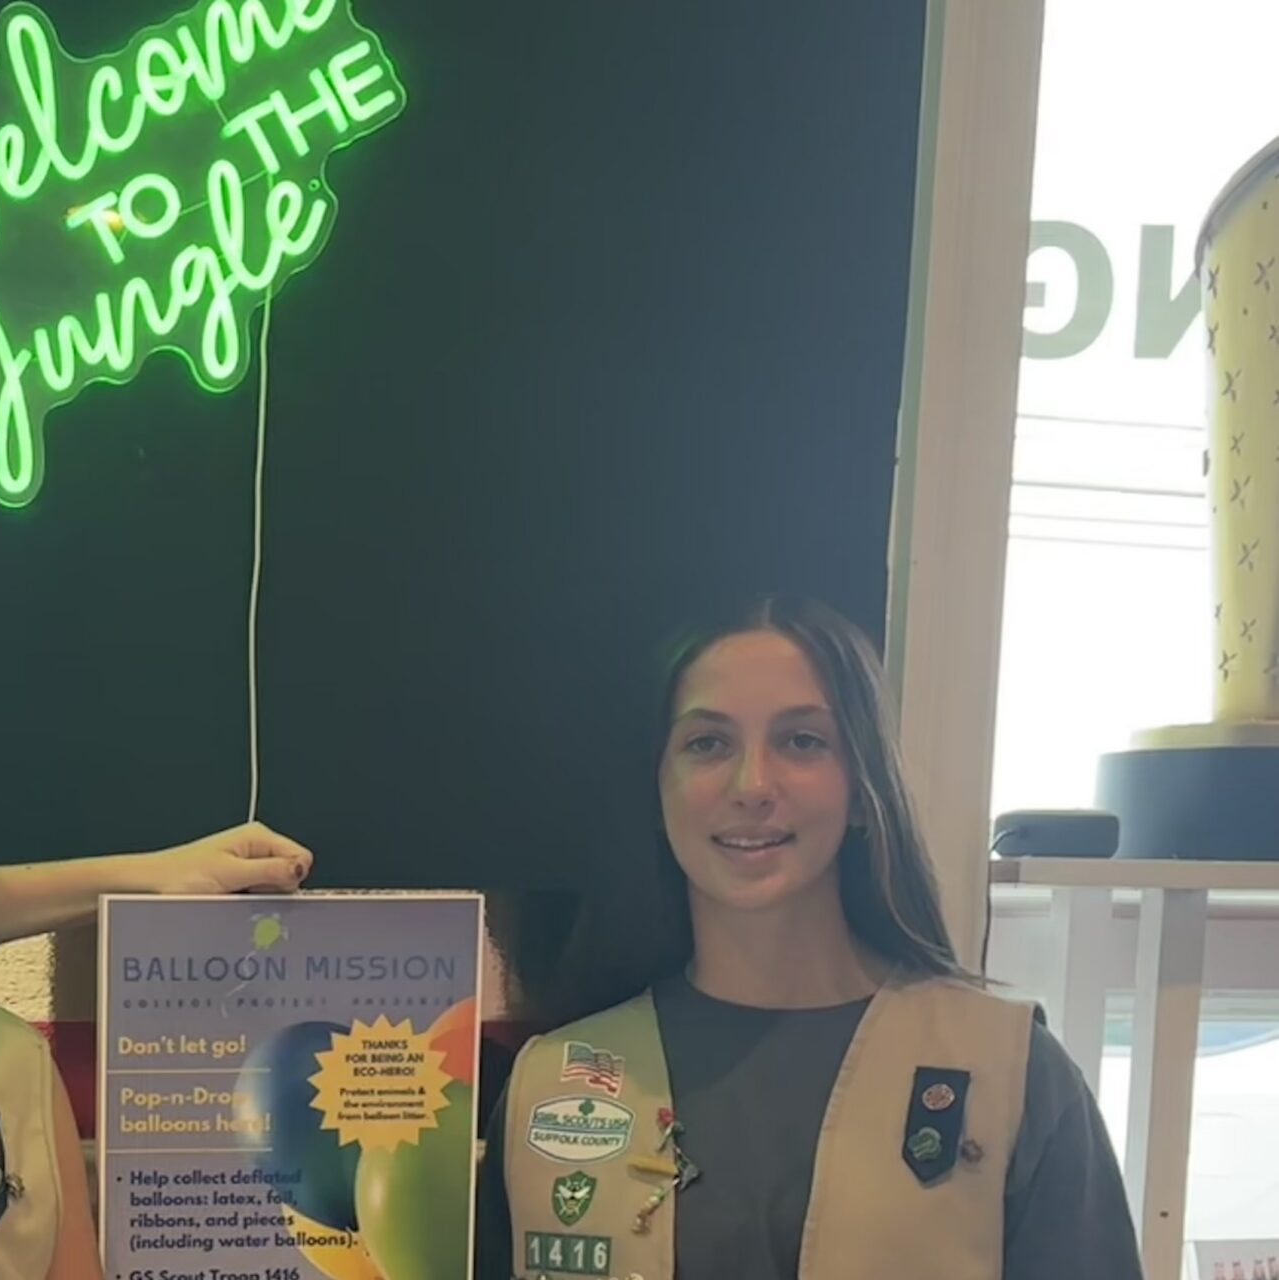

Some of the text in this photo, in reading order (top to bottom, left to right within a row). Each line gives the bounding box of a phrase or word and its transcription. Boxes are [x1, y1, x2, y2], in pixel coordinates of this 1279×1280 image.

[223, 40, 398, 174] THE
[65, 172, 182, 266] TO
[123, 955, 456, 982] BALLOON MISSION
[118, 1033, 247, 1059] Don't let go!
[361, 1039, 410, 1050] THANKS
[344, 1053, 425, 1063] FOR BEING AN
[353, 1066, 416, 1077] ECO-HERO!
[120, 1113, 211, 1133] balloons
[532, 1131, 621, 1147] SUFFOLK COUNTY
[129, 1169, 302, 1188] Help collect deflated
[129, 1190, 298, 1207] balloons: latex, foil,
[129, 1212, 295, 1229] ribbons, and pieces
[129, 1232, 359, 1251] (including water balloons).
[530, 1236, 607, 1269] 1416
